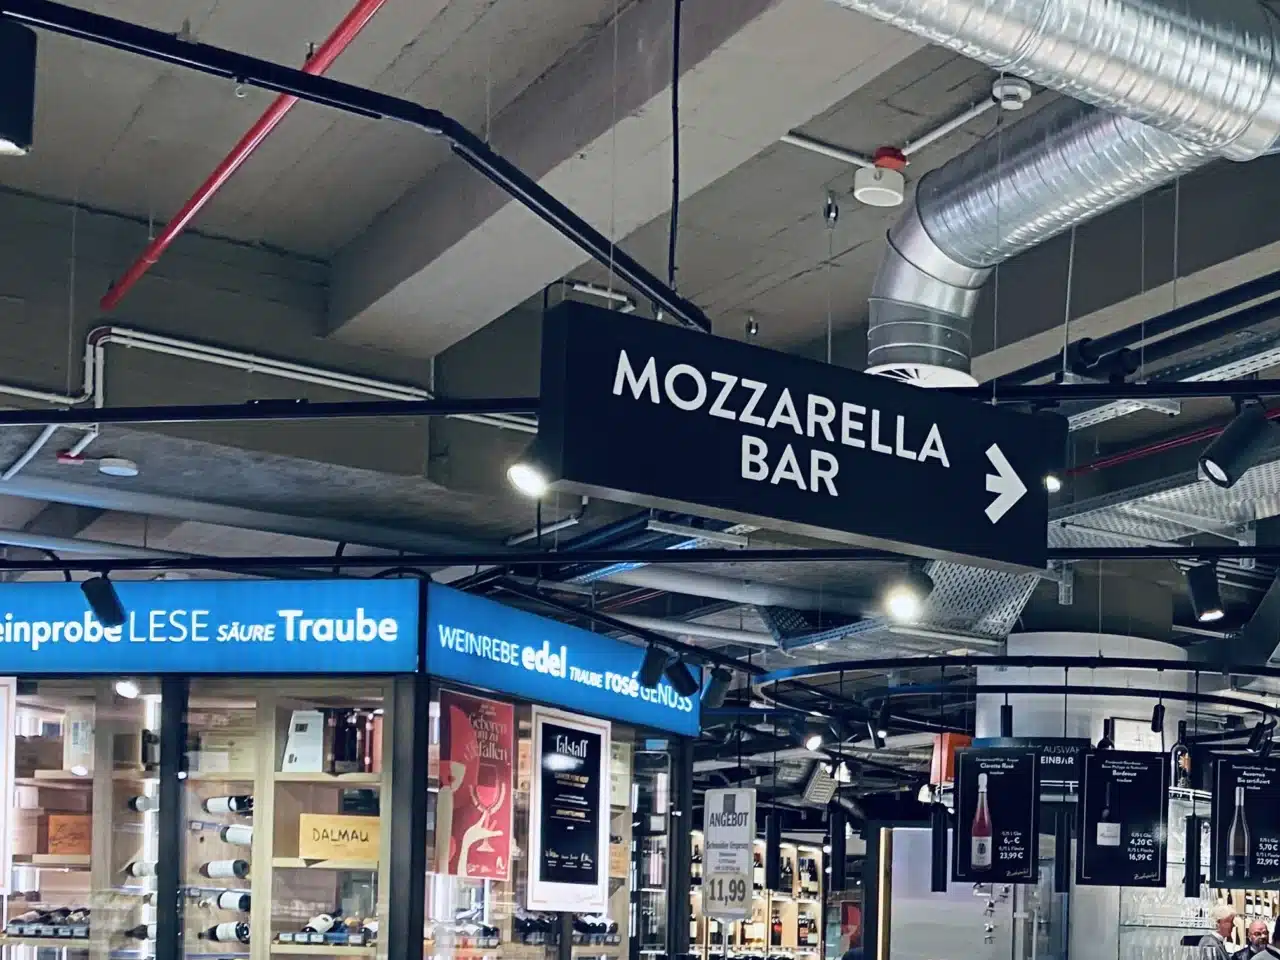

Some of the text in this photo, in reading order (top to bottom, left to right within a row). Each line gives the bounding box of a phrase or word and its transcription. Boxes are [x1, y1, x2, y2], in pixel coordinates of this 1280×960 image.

[612, 349, 950, 468] MOZZARELLA
[741, 435, 839, 496] BAR
[0, 608, 398, 651] inprobe LESE SÄURE Traube
[438, 624, 519, 667] WEINREBE
[521, 640, 567, 679] edel
[569, 666, 603, 689] TRAUBE
[605, 670, 639, 698] rosé
[556, 735, 589, 758] falstaff
[1040, 756, 1074, 765] EINBAR
[709, 812, 749, 827] ANGEBOT
[312, 827, 370, 844] DALMAU
[1130, 838, 1145, 846] 4,20
[1259, 843, 1272, 851] 5,70
[1000, 852, 1017, 860] 23,99
[1129, 853, 1145, 861] 16,99
[709, 878, 746, 906] 11,99
